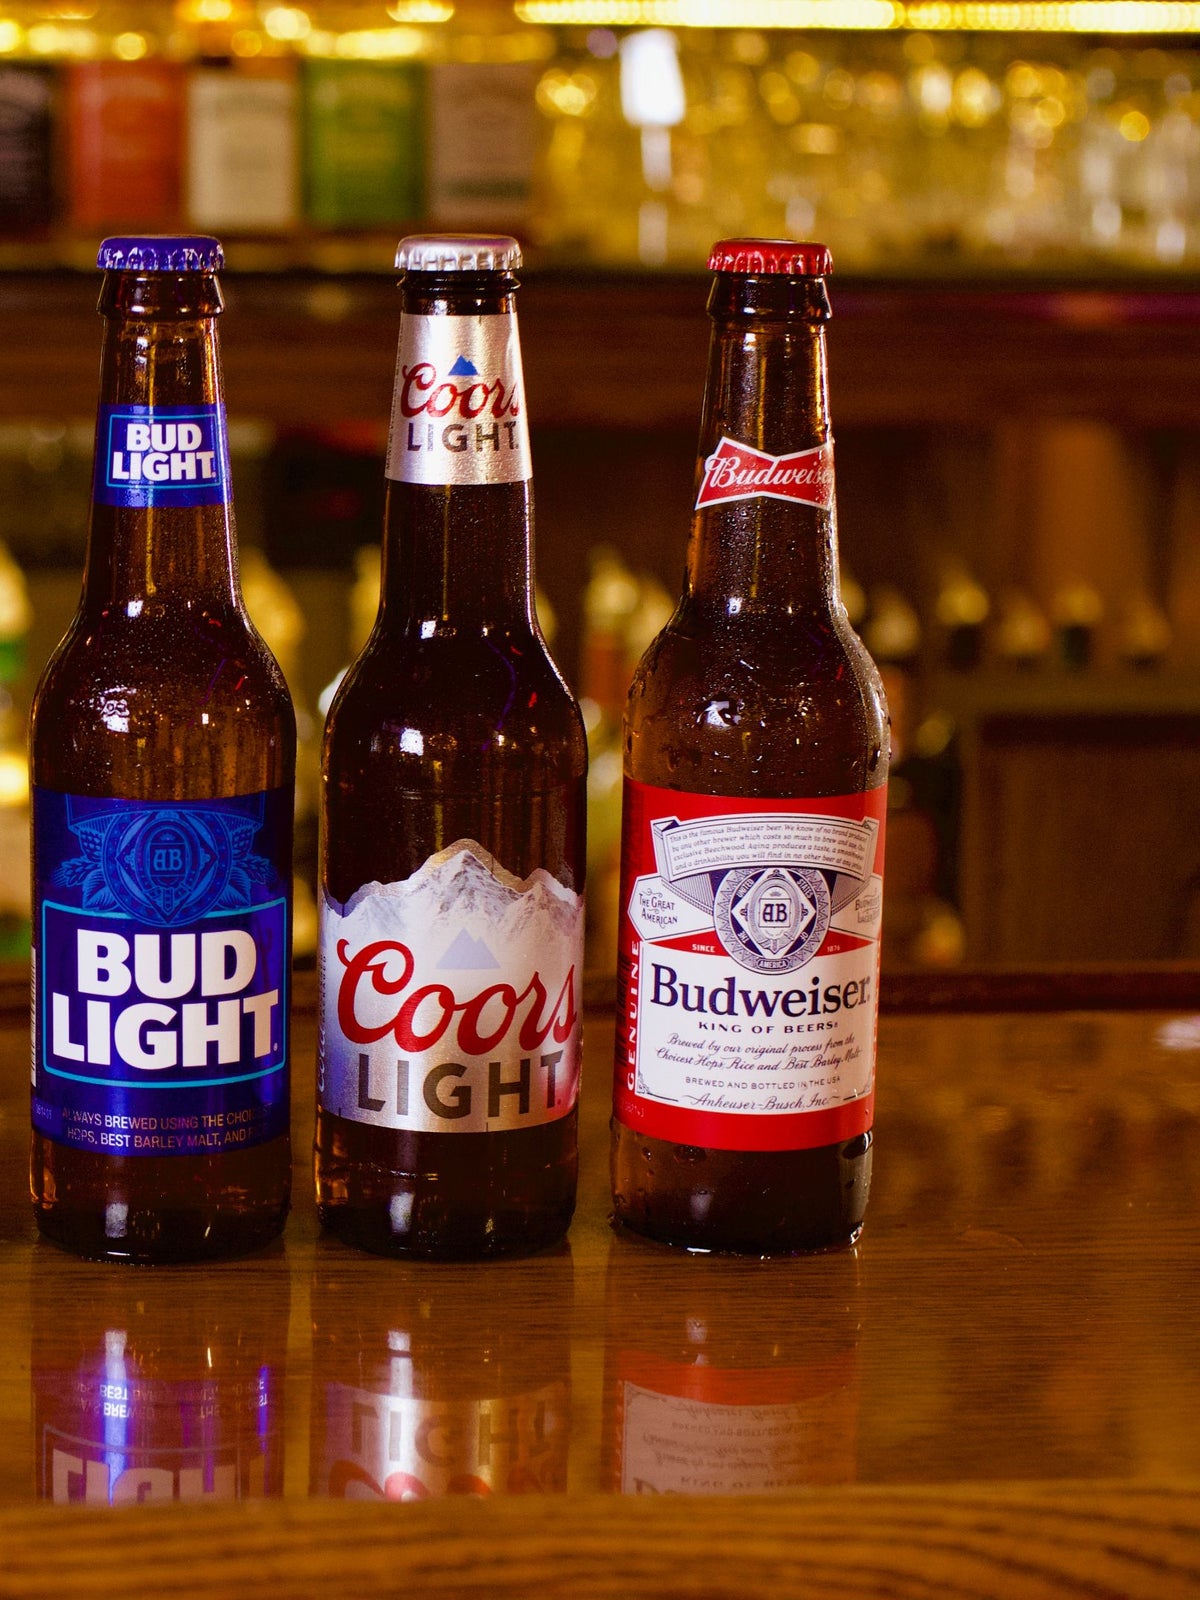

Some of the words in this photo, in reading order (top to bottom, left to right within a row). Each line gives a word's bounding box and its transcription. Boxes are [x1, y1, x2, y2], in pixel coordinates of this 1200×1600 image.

[400, 362, 521, 420] Coors
[126, 423, 202, 452] BUD
[407, 421, 519, 453] LIGHT
[112, 451, 214, 481] LIGHT
[700, 828, 725, 836] famous
[726, 825, 764, 833] Budweiser
[712, 836, 737, 844] brewer
[153, 848, 183, 872] AB
[704, 843, 745, 854] Beechwood
[772, 842, 806, 851] produces
[736, 879, 755, 898] UNITED
[796, 879, 814, 899] STATES
[762, 903, 788, 922] AB
[691, 943, 716, 953] SINCE
[77, 928, 258, 1000] BUD
[759, 960, 788, 968] AMERICA
[336, 938, 578, 1056] Coors
[650, 962, 870, 1018] Budweiser
[627, 940, 640, 1091] GENUINE
[698, 1021, 742, 1033] KING
[751, 1025, 775, 1034] OF
[784, 1020, 834, 1034] BEERS
[52, 988, 279, 1070] LIGHT
[666, 1032, 707, 1049] Brewed
[708, 1040, 721, 1056] by
[723, 1045, 741, 1053] our
[745, 1043, 789, 1060] original
[789, 1043, 823, 1056] process
[823, 1037, 844, 1054] from
[844, 1032, 855, 1045] the
[655, 1046, 694, 1065] Choicest
[720, 1056, 755, 1070] Rice
[757, 1060, 781, 1071] and
[782, 1056, 810, 1071] Best
[357, 1050, 564, 1119] LIGHT
[685, 1076, 725, 1088] BREWED
[727, 1082, 748, 1090] AND
[751, 1082, 795, 1090] BOTTLED
[827, 1076, 841, 1084] USA
[62, 1107, 102, 1126] ALWAYS
[104, 1114, 158, 1130] BREWED
[160, 1115, 199, 1130] USING
[201, 1113, 225, 1127] THE
[100, 1132, 131, 1147] BEST
[134, 1135, 185, 1149] BARLEY
[187, 1132, 222, 1147] MALT,
[224, 1128, 246, 1144] AND
